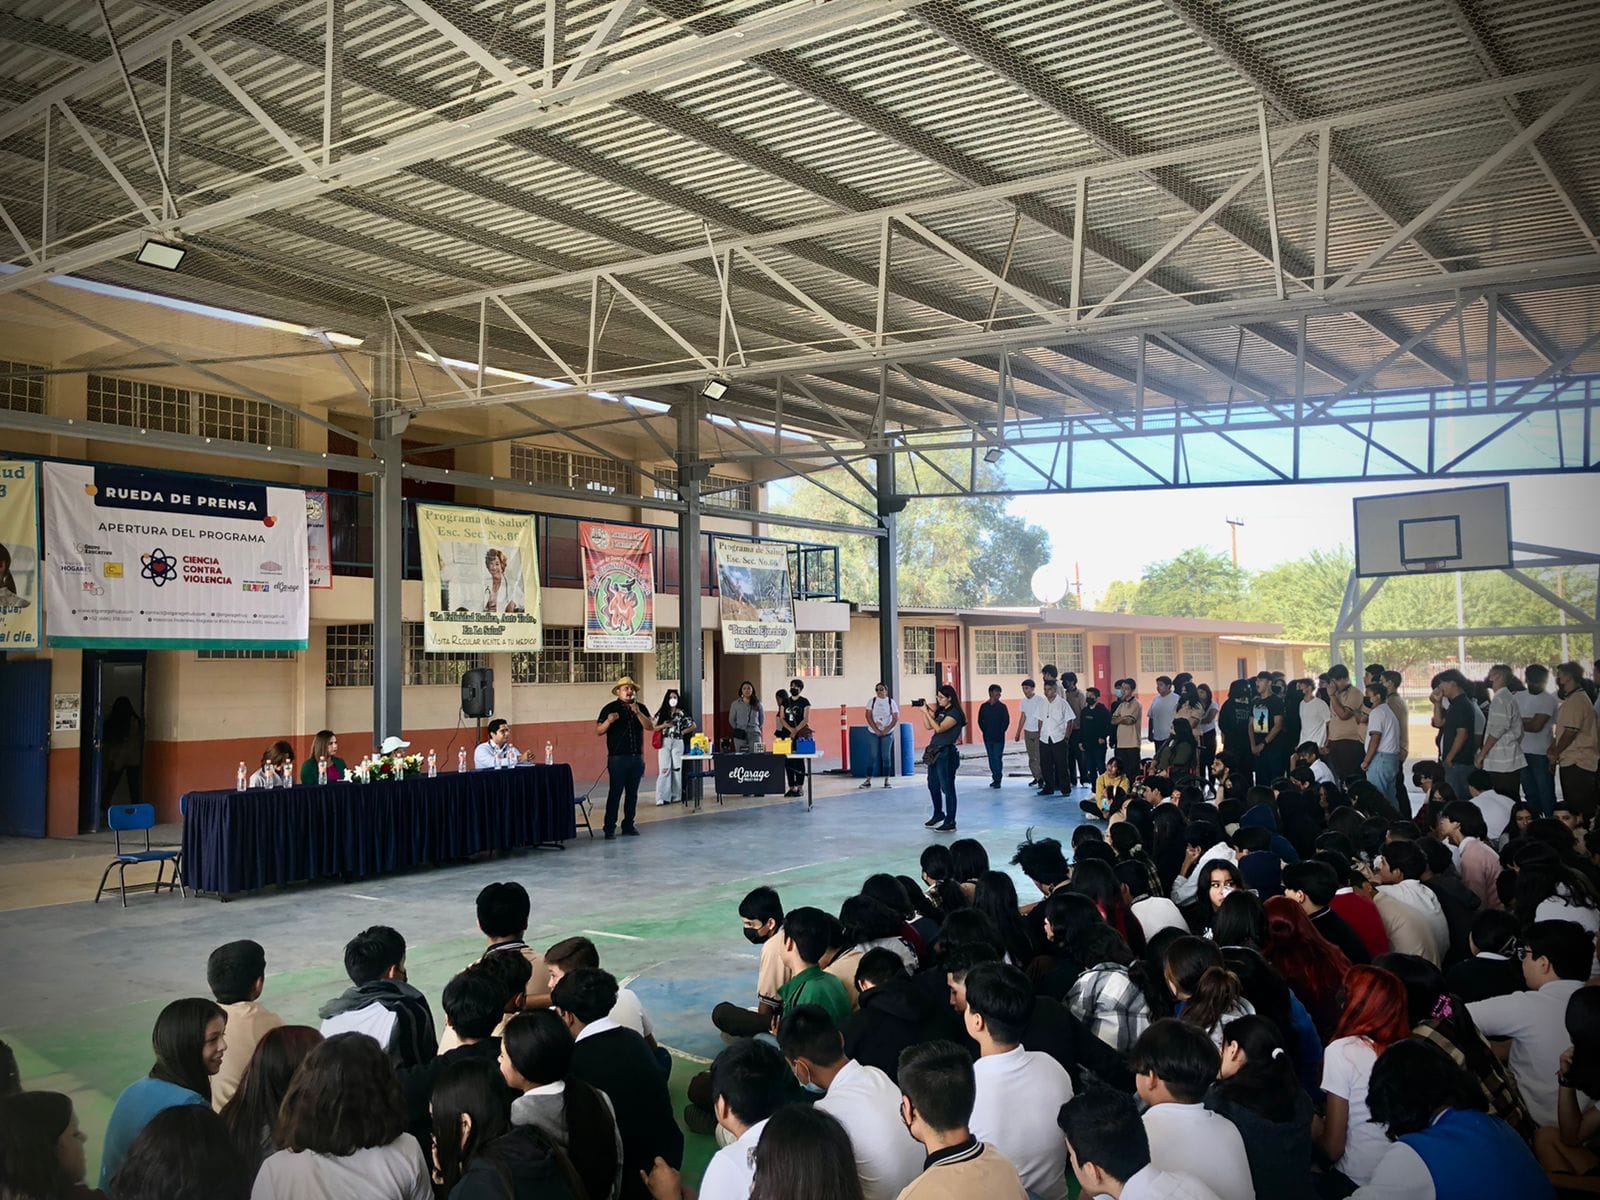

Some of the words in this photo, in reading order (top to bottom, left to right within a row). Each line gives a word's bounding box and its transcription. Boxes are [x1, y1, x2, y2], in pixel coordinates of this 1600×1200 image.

[105, 486, 164, 503] RUEDA
[170, 493, 192, 505] DE
[197, 496, 258, 512] PRENSA
[425, 510, 480, 524] Programa
[484, 515, 496, 526] de
[98, 522, 168, 536] APERTURA
[171, 527, 196, 539] DEL
[199, 530, 266, 544] PROGRAMA
[437, 526, 460, 537] Esc.
[718, 542, 754, 553] Programa
[182, 555, 220, 565] CIENCIA
[182, 565, 223, 575] CONTRA
[183, 574, 233, 585] VIOLENCIA
